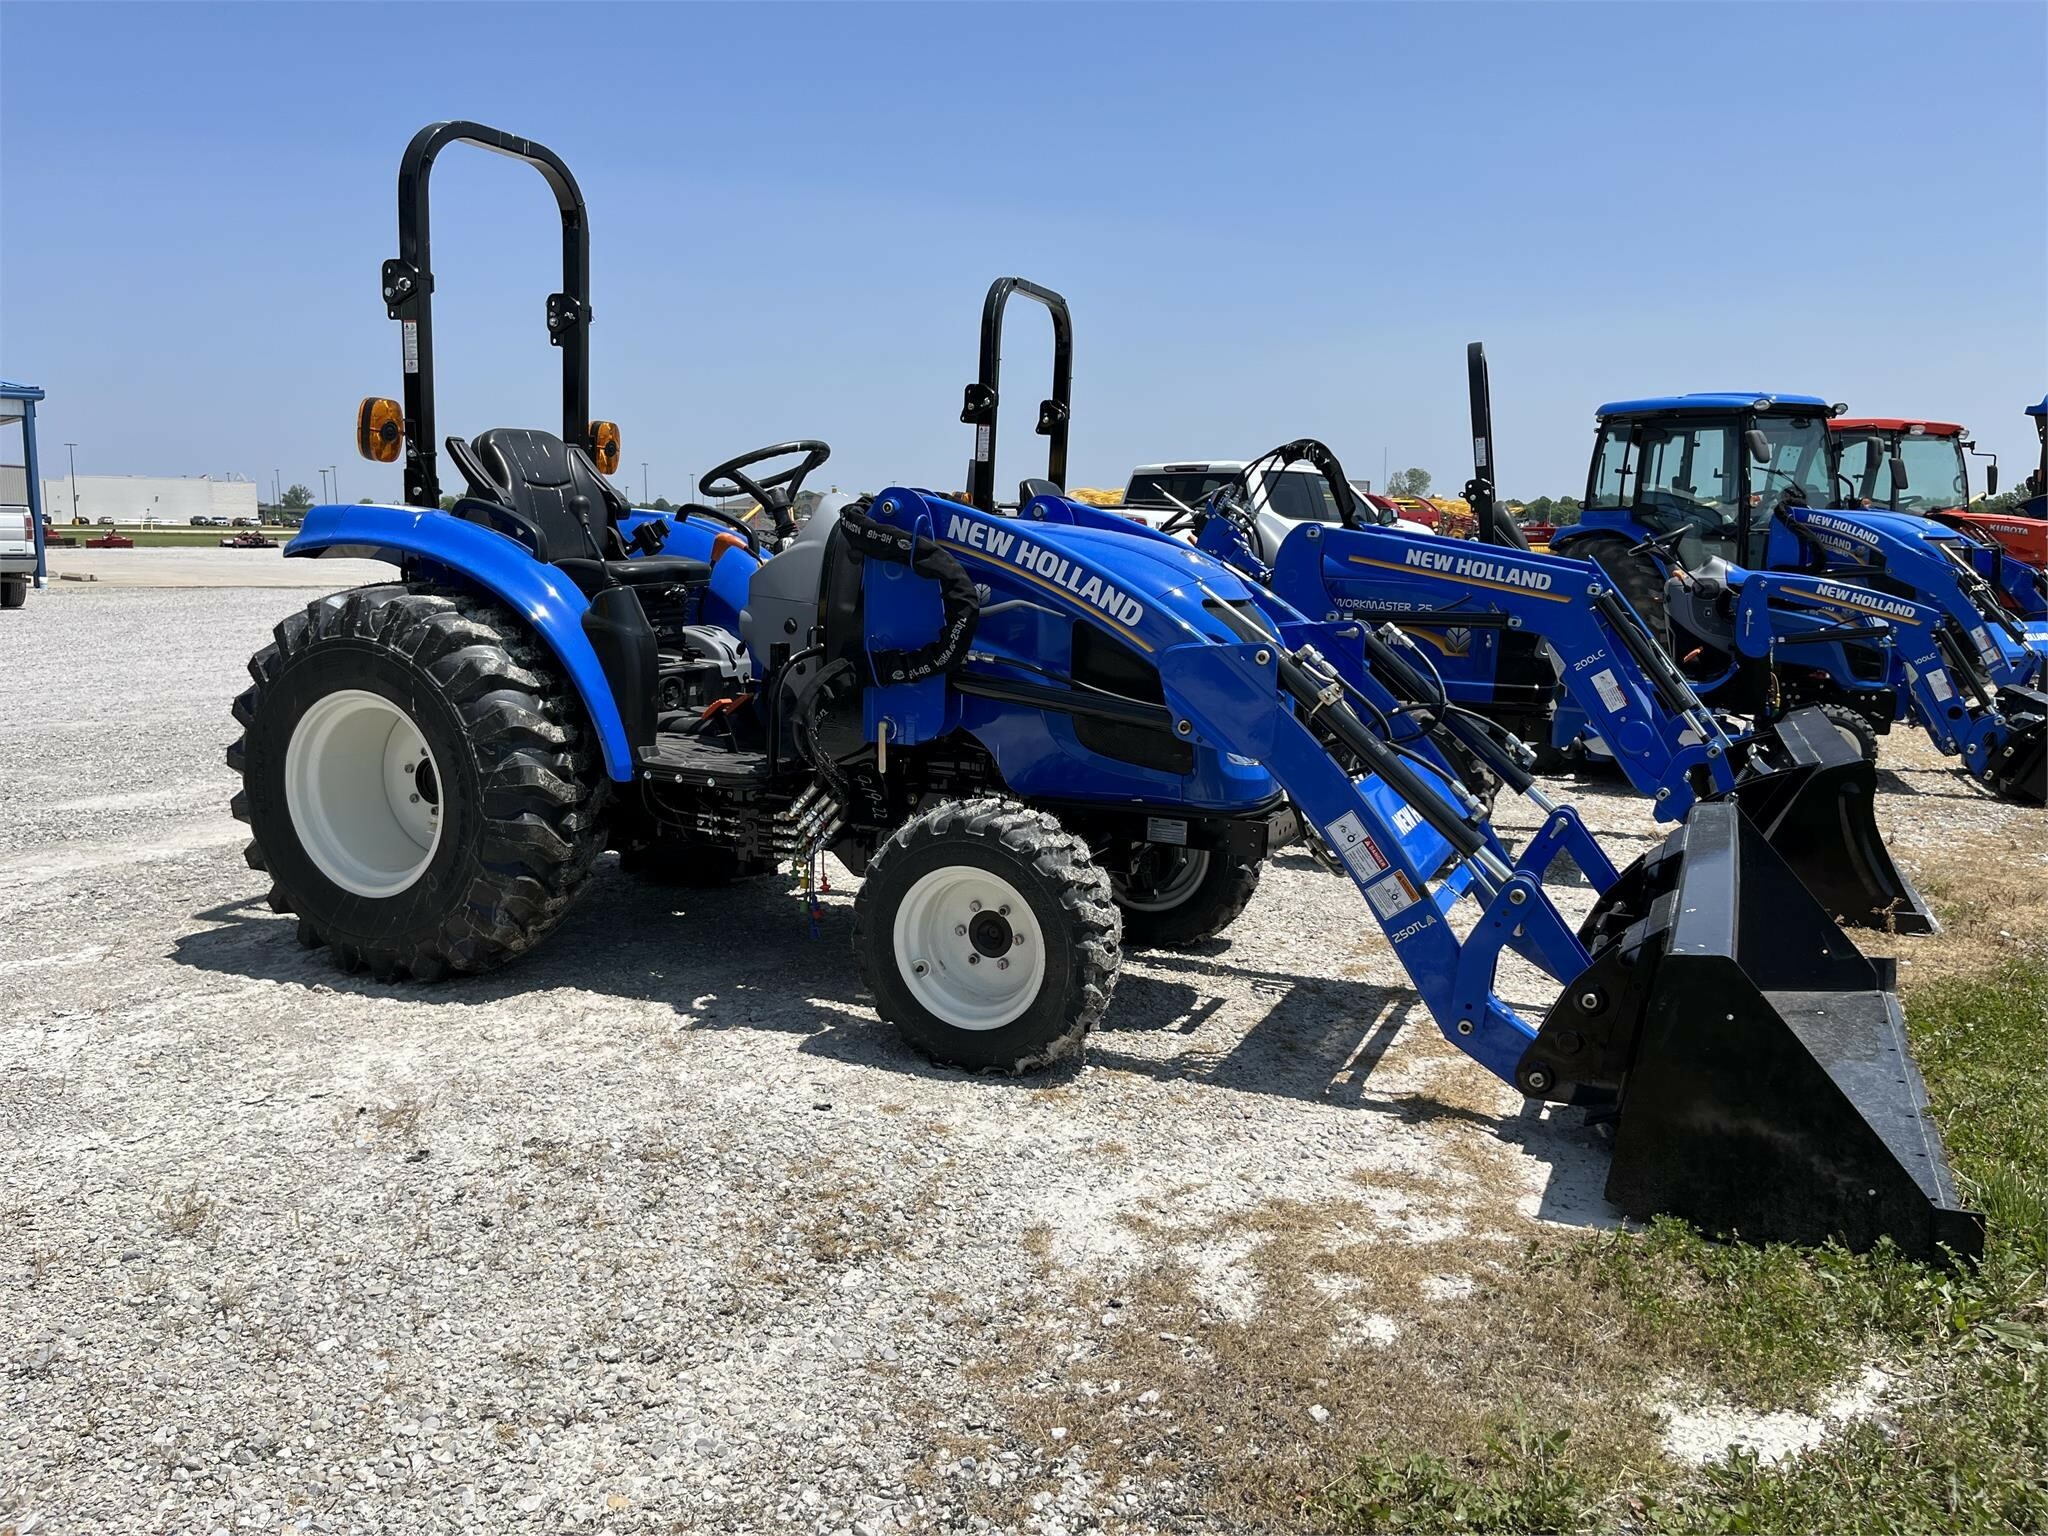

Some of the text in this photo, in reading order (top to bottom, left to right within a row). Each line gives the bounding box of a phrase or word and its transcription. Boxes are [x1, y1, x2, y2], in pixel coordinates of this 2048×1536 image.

[1807, 514, 1879, 545] NEW HOLLAND
[1989, 524, 2029, 535] KUBOTA
[947, 514, 1144, 627] NEW HOLLAND
[1405, 548, 1552, 591] NEW HOLLAND
[1334, 598, 1434, 612] WORKMASTER 25
[1816, 583, 1916, 618] NEW HOLLAND
[1573, 649, 1606, 671] 200LC
[1914, 652, 1937, 665] 100LC
[1391, 805, 1418, 836] NEW
